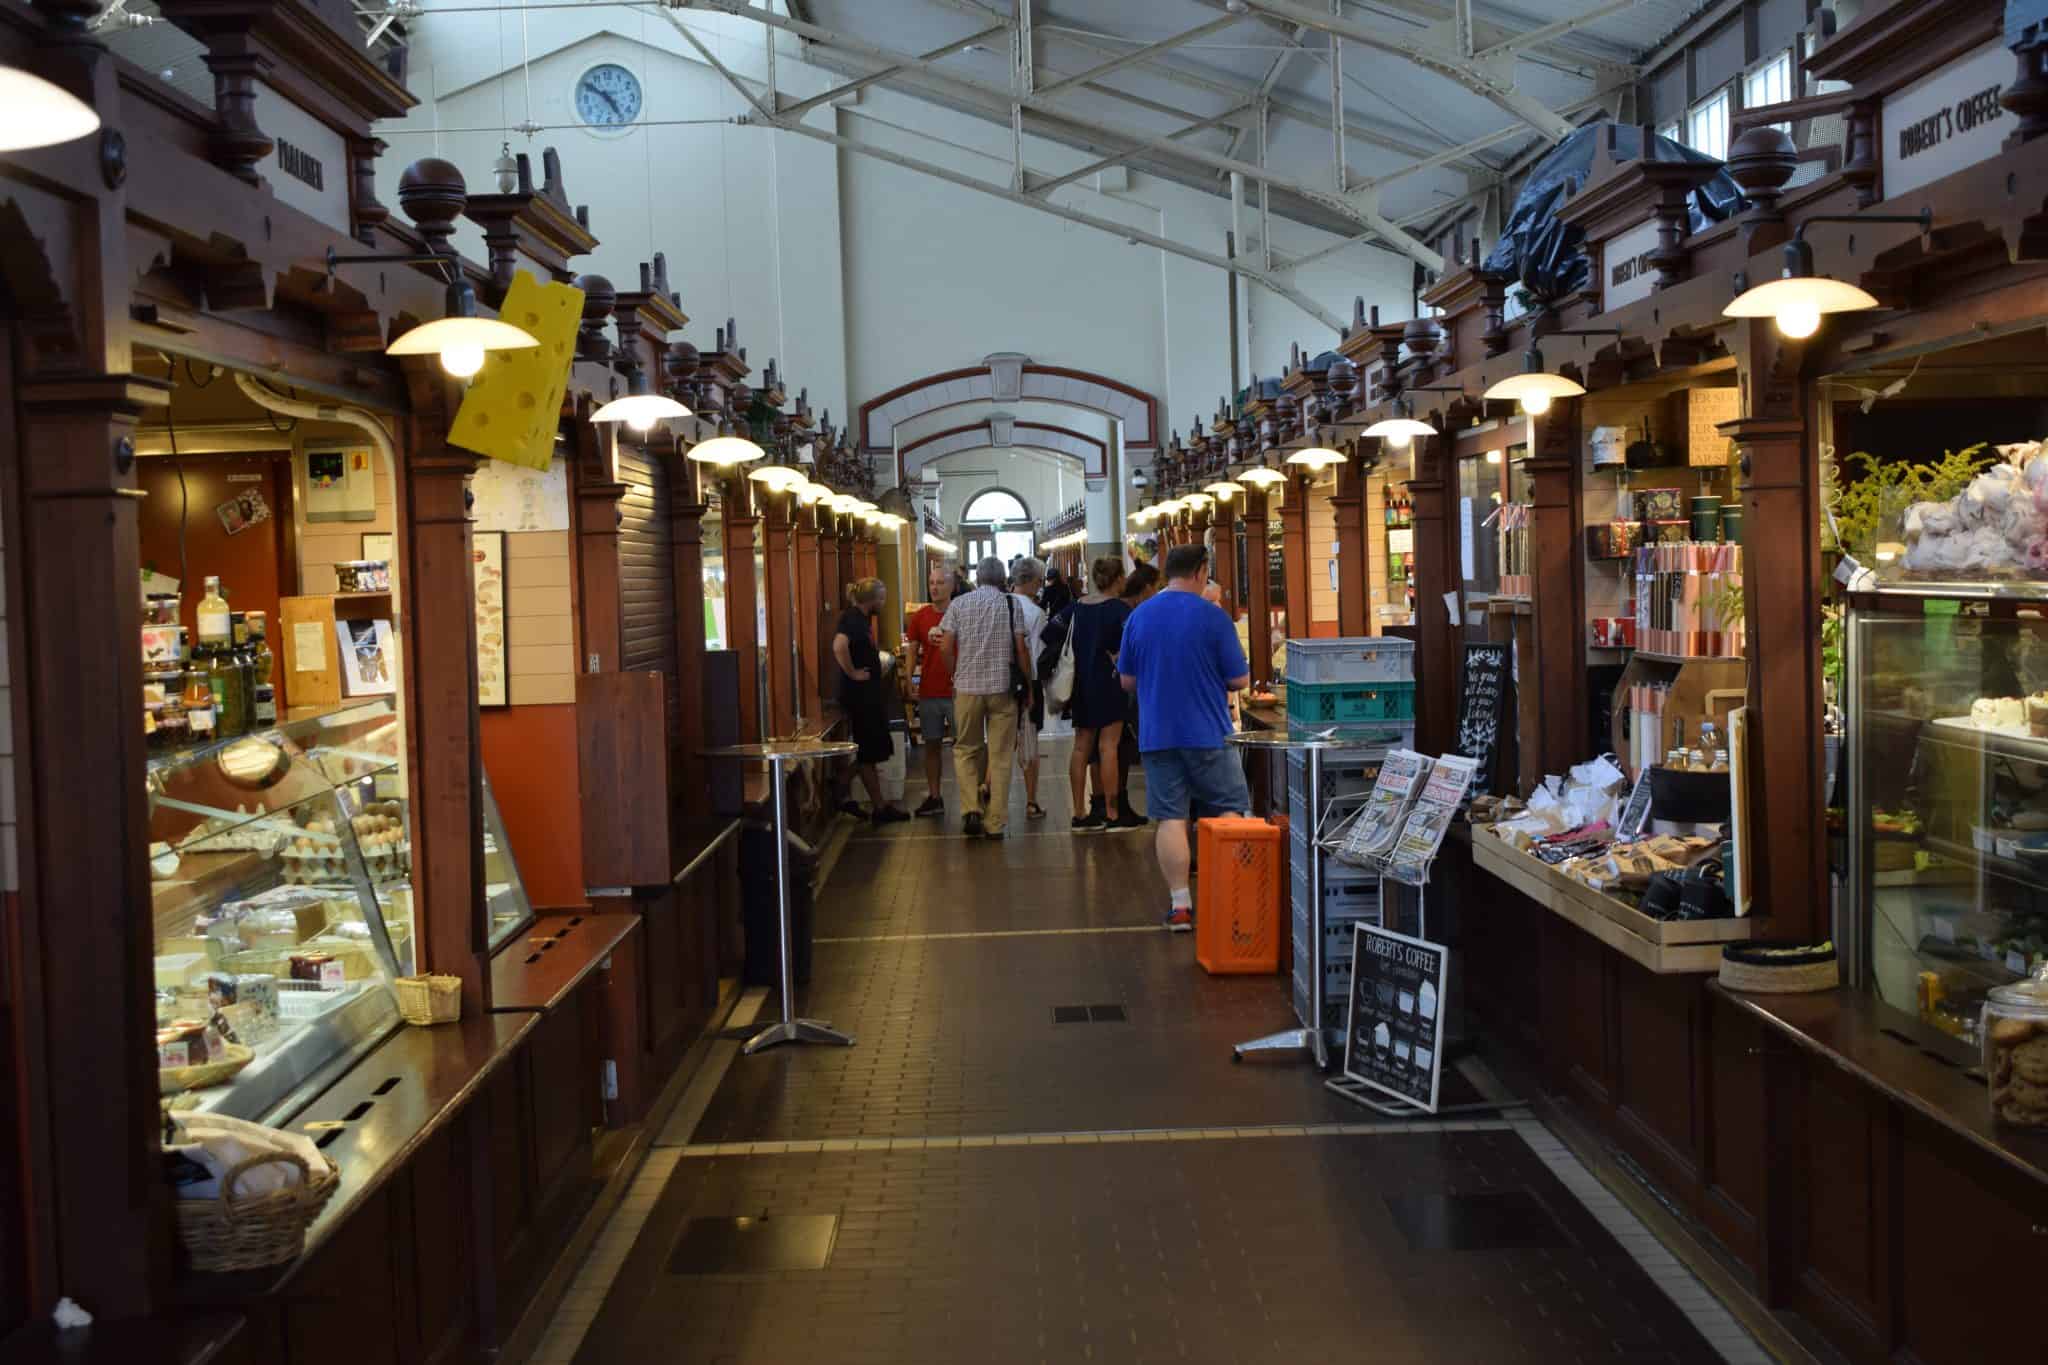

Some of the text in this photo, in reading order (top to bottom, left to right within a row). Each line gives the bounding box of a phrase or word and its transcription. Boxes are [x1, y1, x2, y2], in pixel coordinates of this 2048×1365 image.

[1899, 83, 2003, 160] ROBERT'S COFFEE
[1405, 946, 1435, 975] COFFEE
